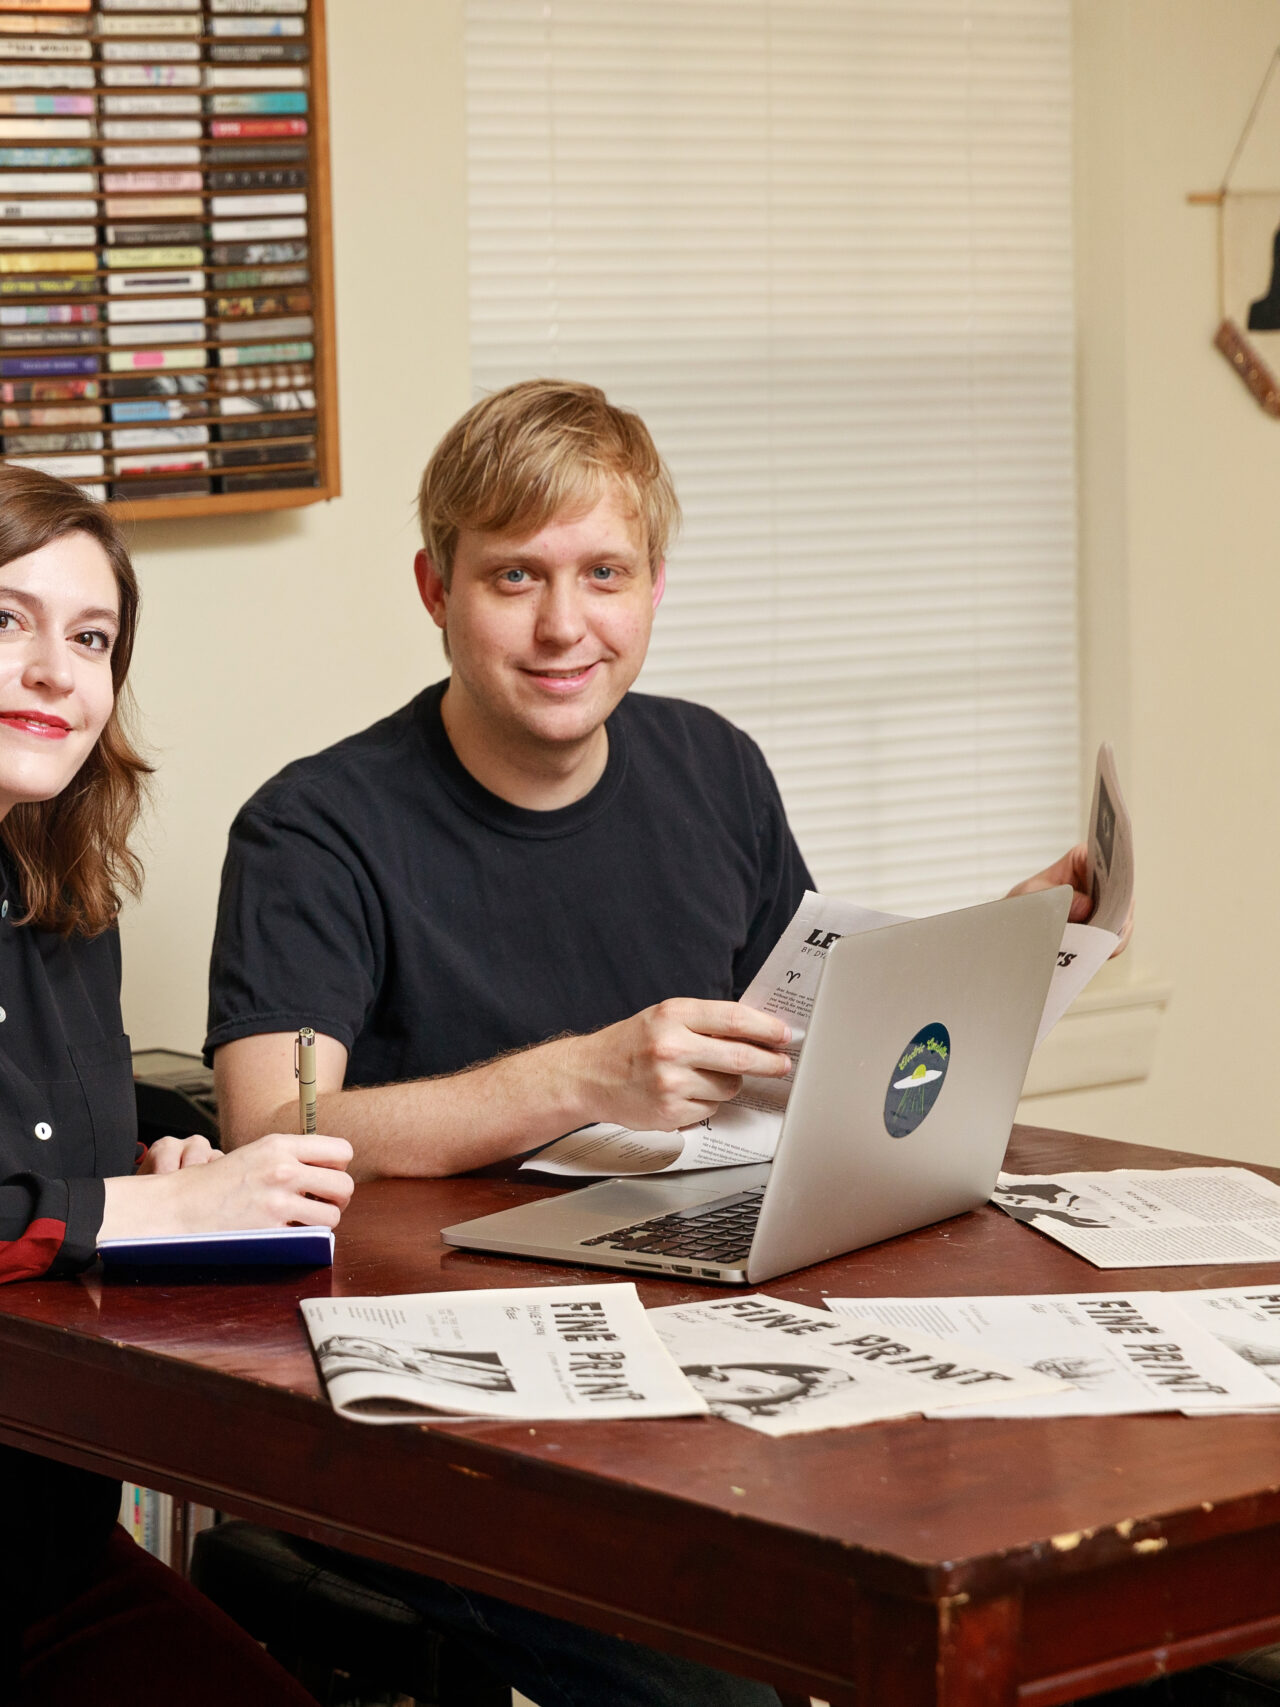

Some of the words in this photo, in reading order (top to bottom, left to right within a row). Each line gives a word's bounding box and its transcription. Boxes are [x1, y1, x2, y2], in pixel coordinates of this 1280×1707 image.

[801, 946, 812, 955] BY
[550, 1302, 618, 1341] FINE
[710, 1300, 840, 1336] FINE
[829, 1334, 1015, 1385] PRINT
[1077, 1300, 1162, 1334] FINE
[1122, 1343, 1230, 1394] PRINT
[568, 1351, 646, 1402] PRINT
